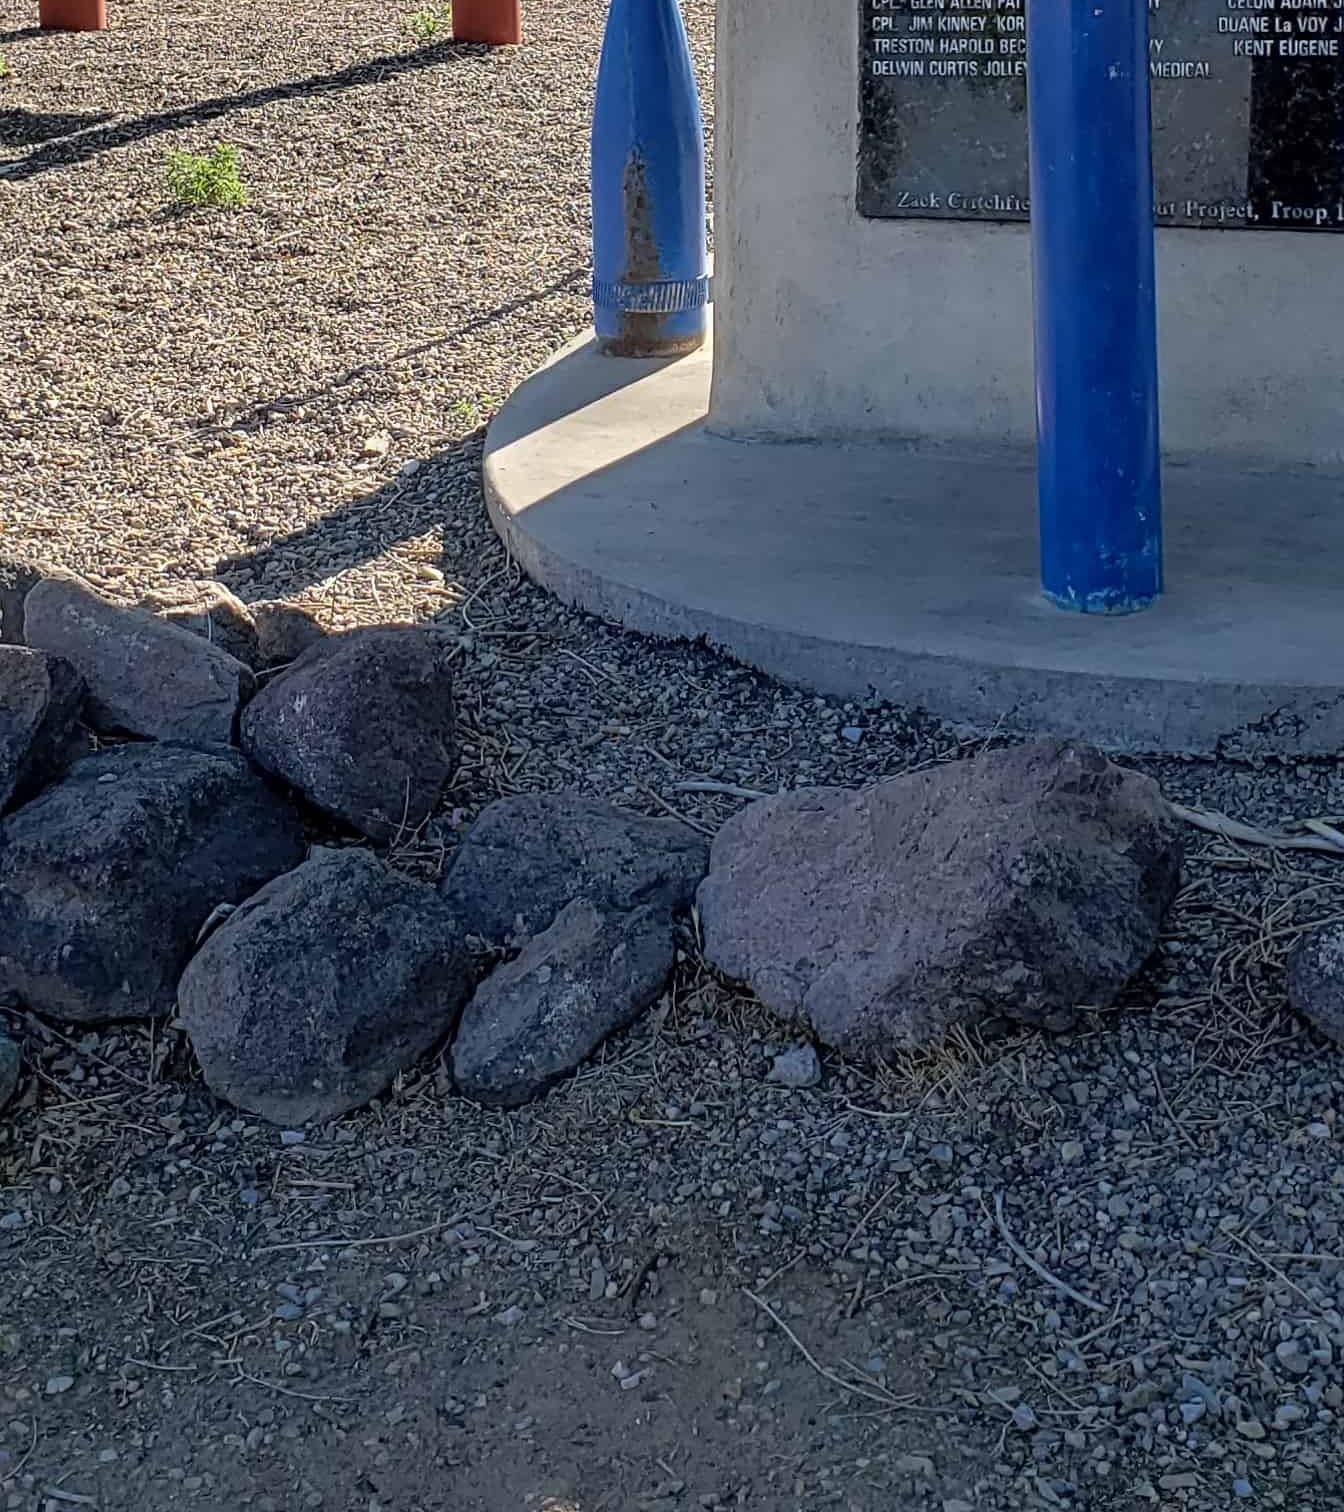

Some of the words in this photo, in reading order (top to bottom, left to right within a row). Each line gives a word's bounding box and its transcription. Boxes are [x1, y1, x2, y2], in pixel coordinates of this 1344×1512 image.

[909, 16, 933, 31] JIM
[938, 16, 986, 31] KINNEY
[996, 15, 1025, 31] KOR
[1218, 16, 1269, 33] DUANE
[1275, 16, 1292, 32] La
[1297, 16, 1328, 32] VOY
[873, 38, 934, 54] TRESTON
[940, 38, 994, 54] HAROLD
[999, 38, 1026, 54] BEC
[1233, 39, 1274, 56] KENT
[1279, 39, 1339, 56] EUGENE
[872, 60, 924, 76] DELWIN
[929, 60, 978, 76] CURTIS
[1149, 61, 1210, 78] MEDICAL
[896, 191, 940, 209] Zack
[947, 192, 1031, 211] Critchfie
[1186, 200, 1260, 222] Project,
